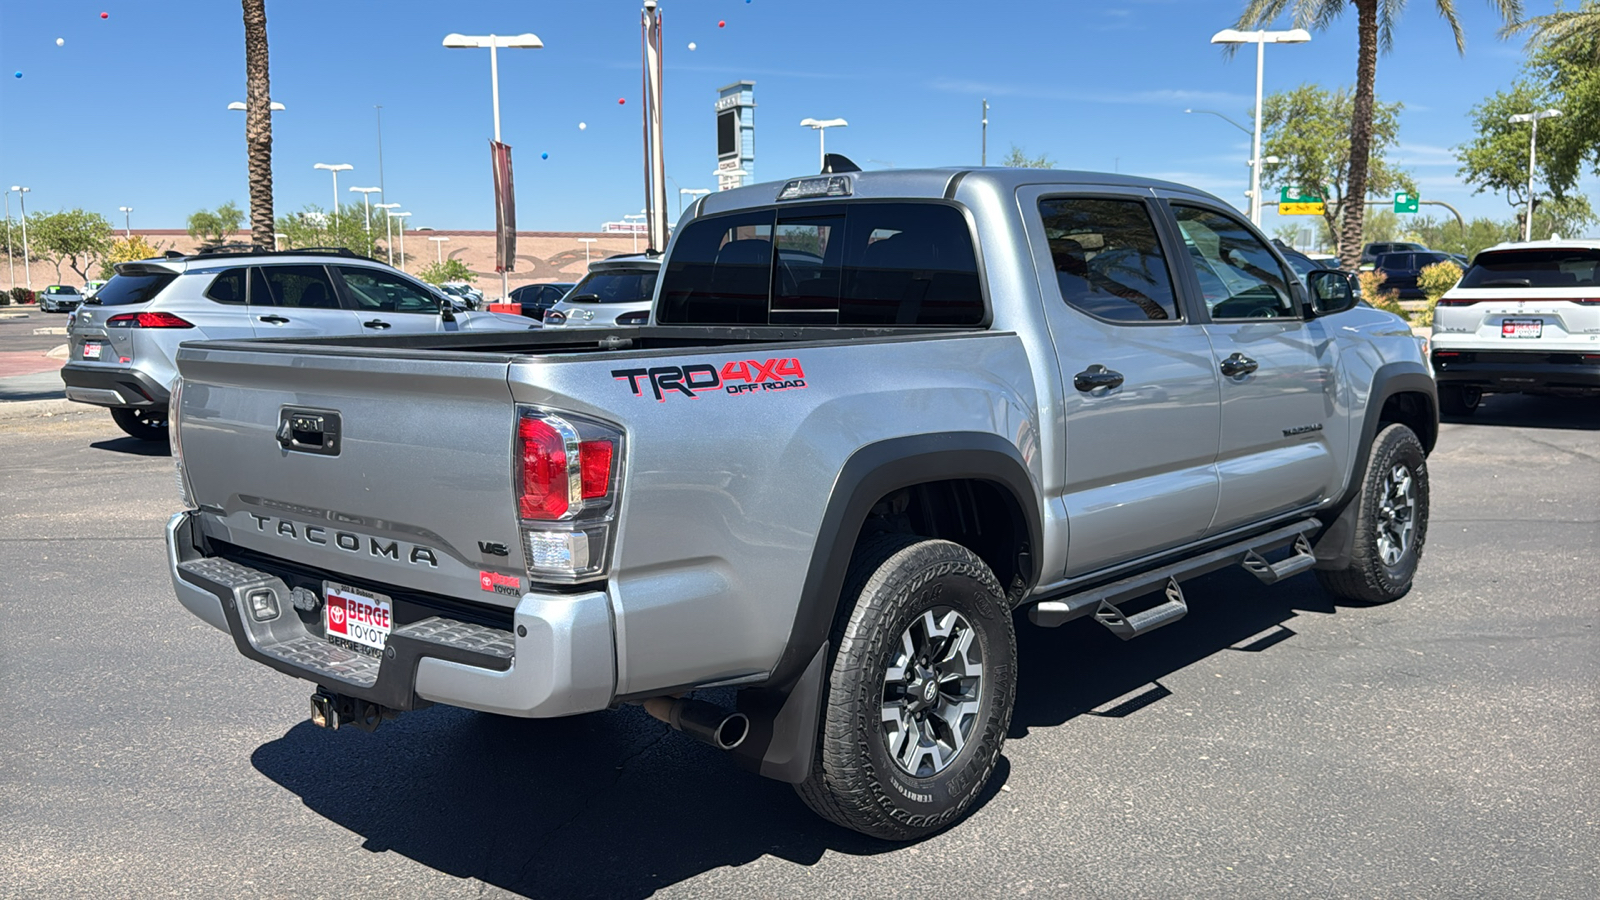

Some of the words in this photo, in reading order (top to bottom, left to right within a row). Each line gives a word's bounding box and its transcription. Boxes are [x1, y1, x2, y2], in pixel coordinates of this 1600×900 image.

[611, 364, 723, 403] TRD
[721, 358, 805, 383] 4X4
[726, 382, 760, 396] OFF
[763, 379, 808, 392] ROAD
[249, 512, 439, 568] TACOMA
[477, 540, 511, 557] V6
[493, 584, 521, 597] TOYOTA
[348, 599, 389, 628] BERGE
[328, 636, 359, 652] BERGE
[890, 776, 934, 803] TERRITORY
